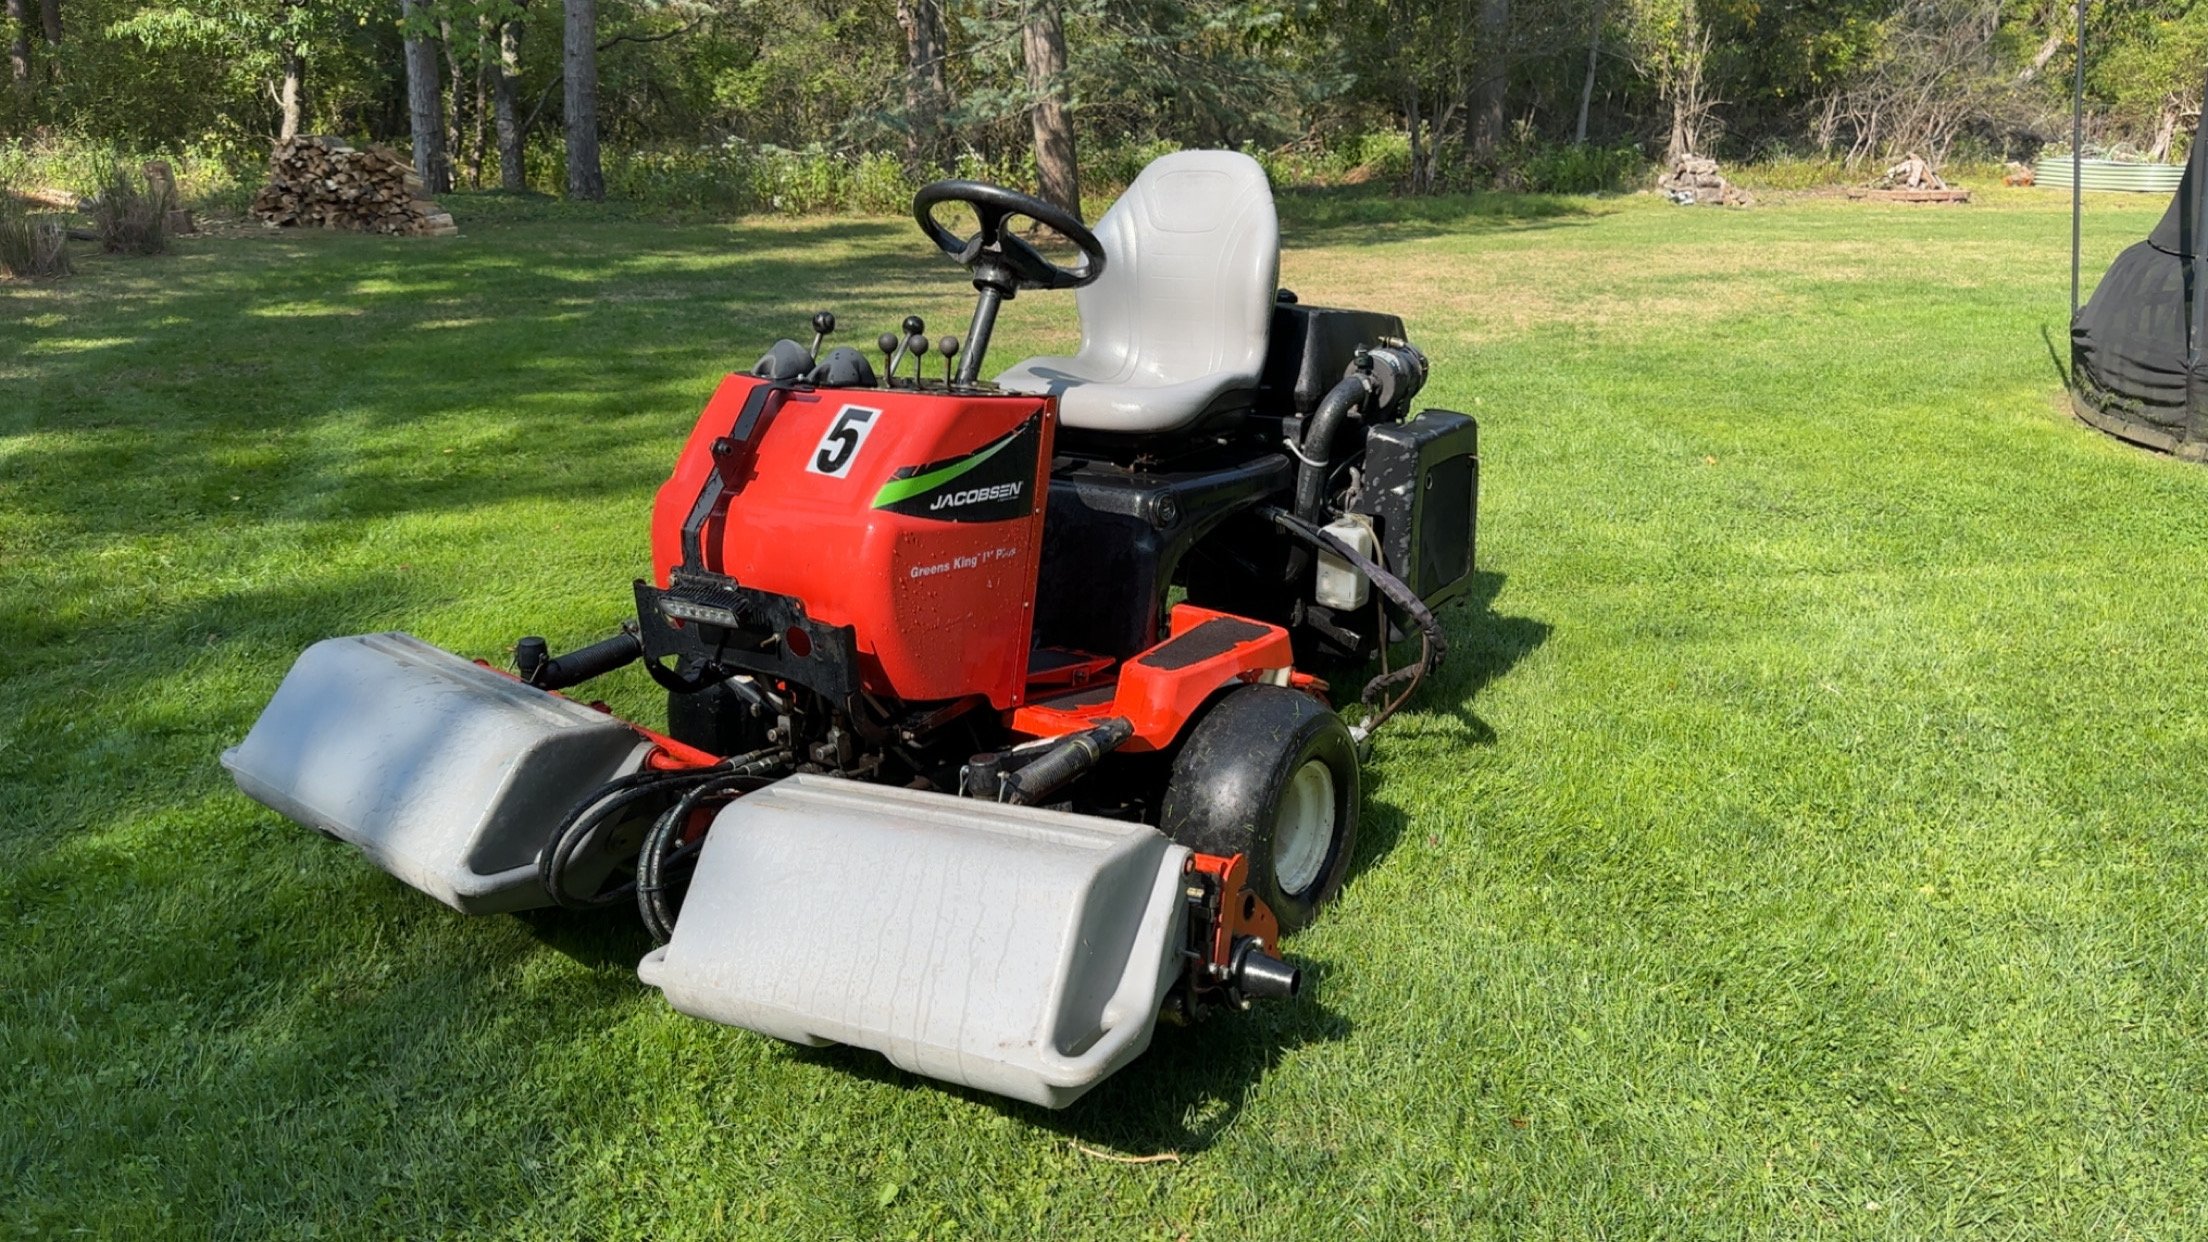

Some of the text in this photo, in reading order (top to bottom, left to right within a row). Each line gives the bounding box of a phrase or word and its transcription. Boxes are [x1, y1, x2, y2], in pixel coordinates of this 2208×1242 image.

[817, 408, 873, 473] 5
[930, 481, 1022, 510] JACOBSEN
[911, 562, 950, 577] Greens
[953, 556, 977, 569] King
